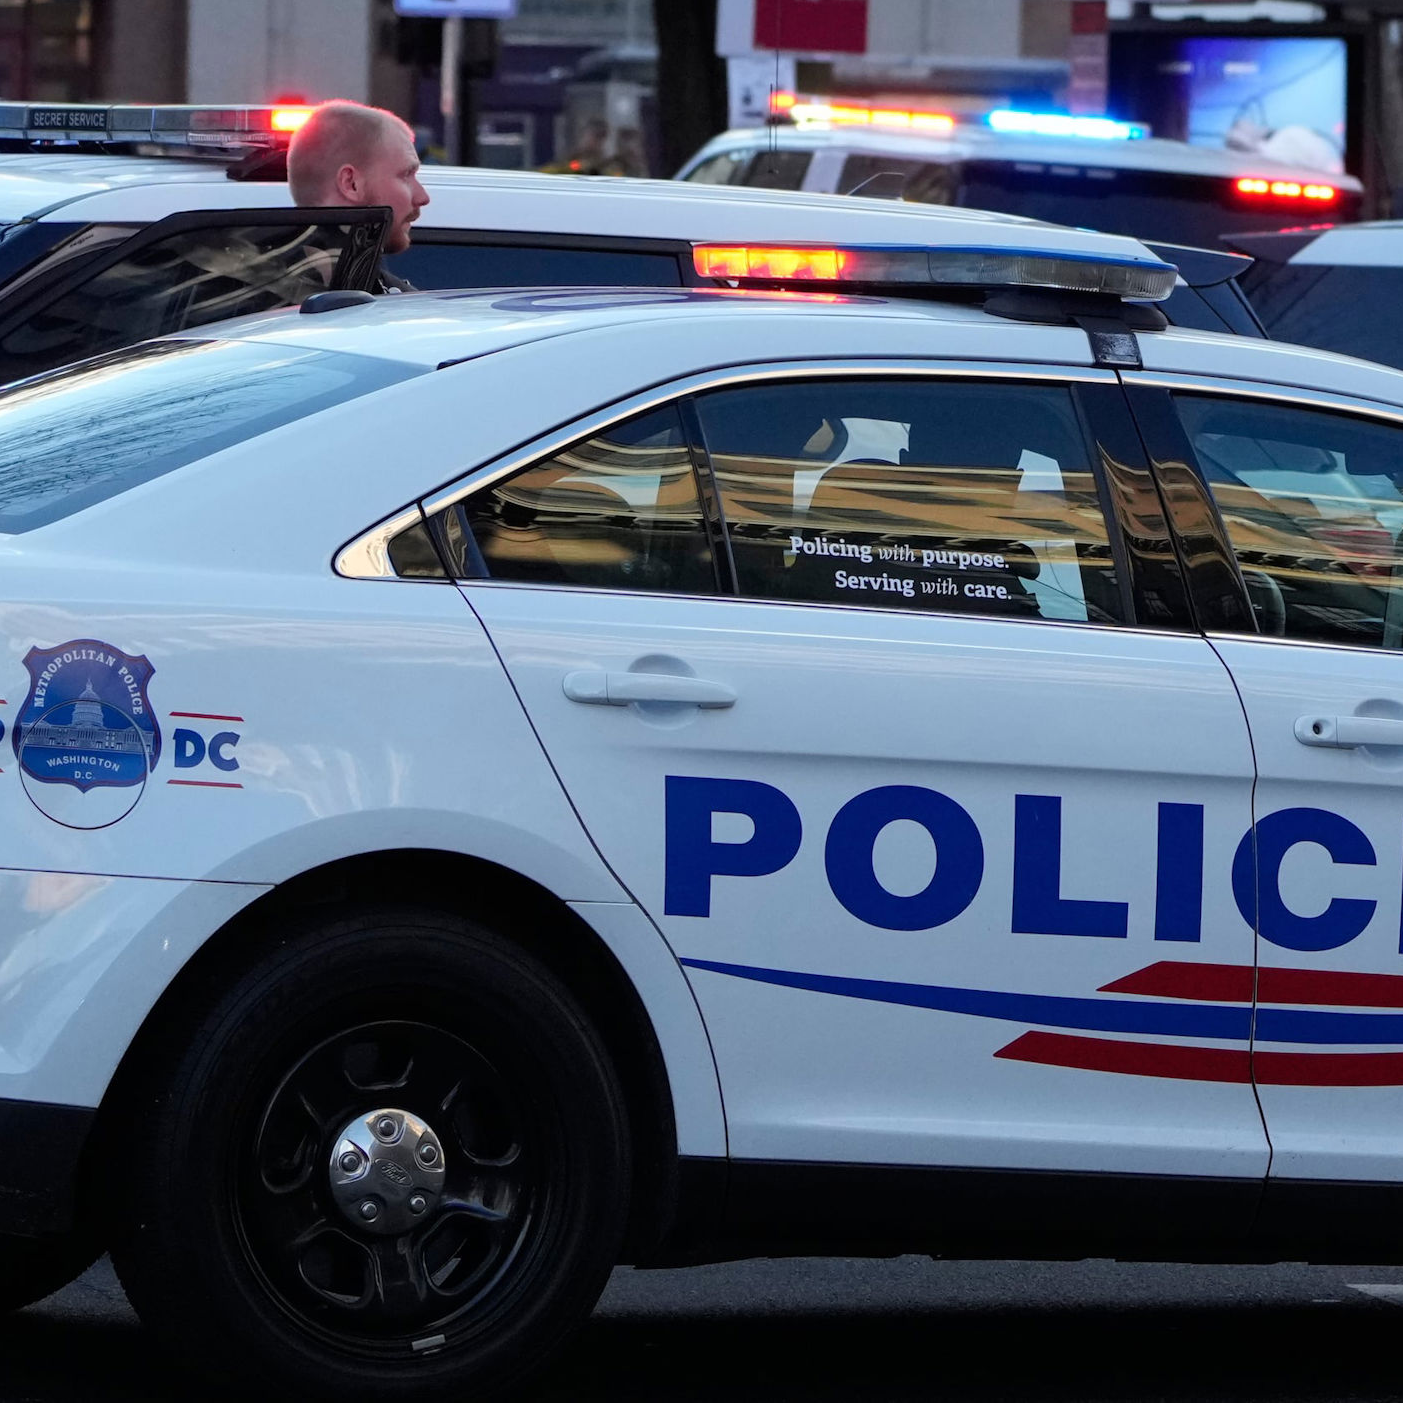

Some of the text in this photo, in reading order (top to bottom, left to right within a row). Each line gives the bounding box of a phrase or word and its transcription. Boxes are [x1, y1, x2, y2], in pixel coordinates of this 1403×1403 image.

[34, 112, 105, 127] SECRET SERVICE
[789, 536, 1010, 570] Policing with purpose.
[834, 570, 1012, 600] Serving with care.
[33, 649, 143, 715] METROPOLITAN POLICE
[46, 754, 120, 772] WASHINGTON
[172, 728, 241, 772] DC
[74, 770, 96, 780] D.C.
